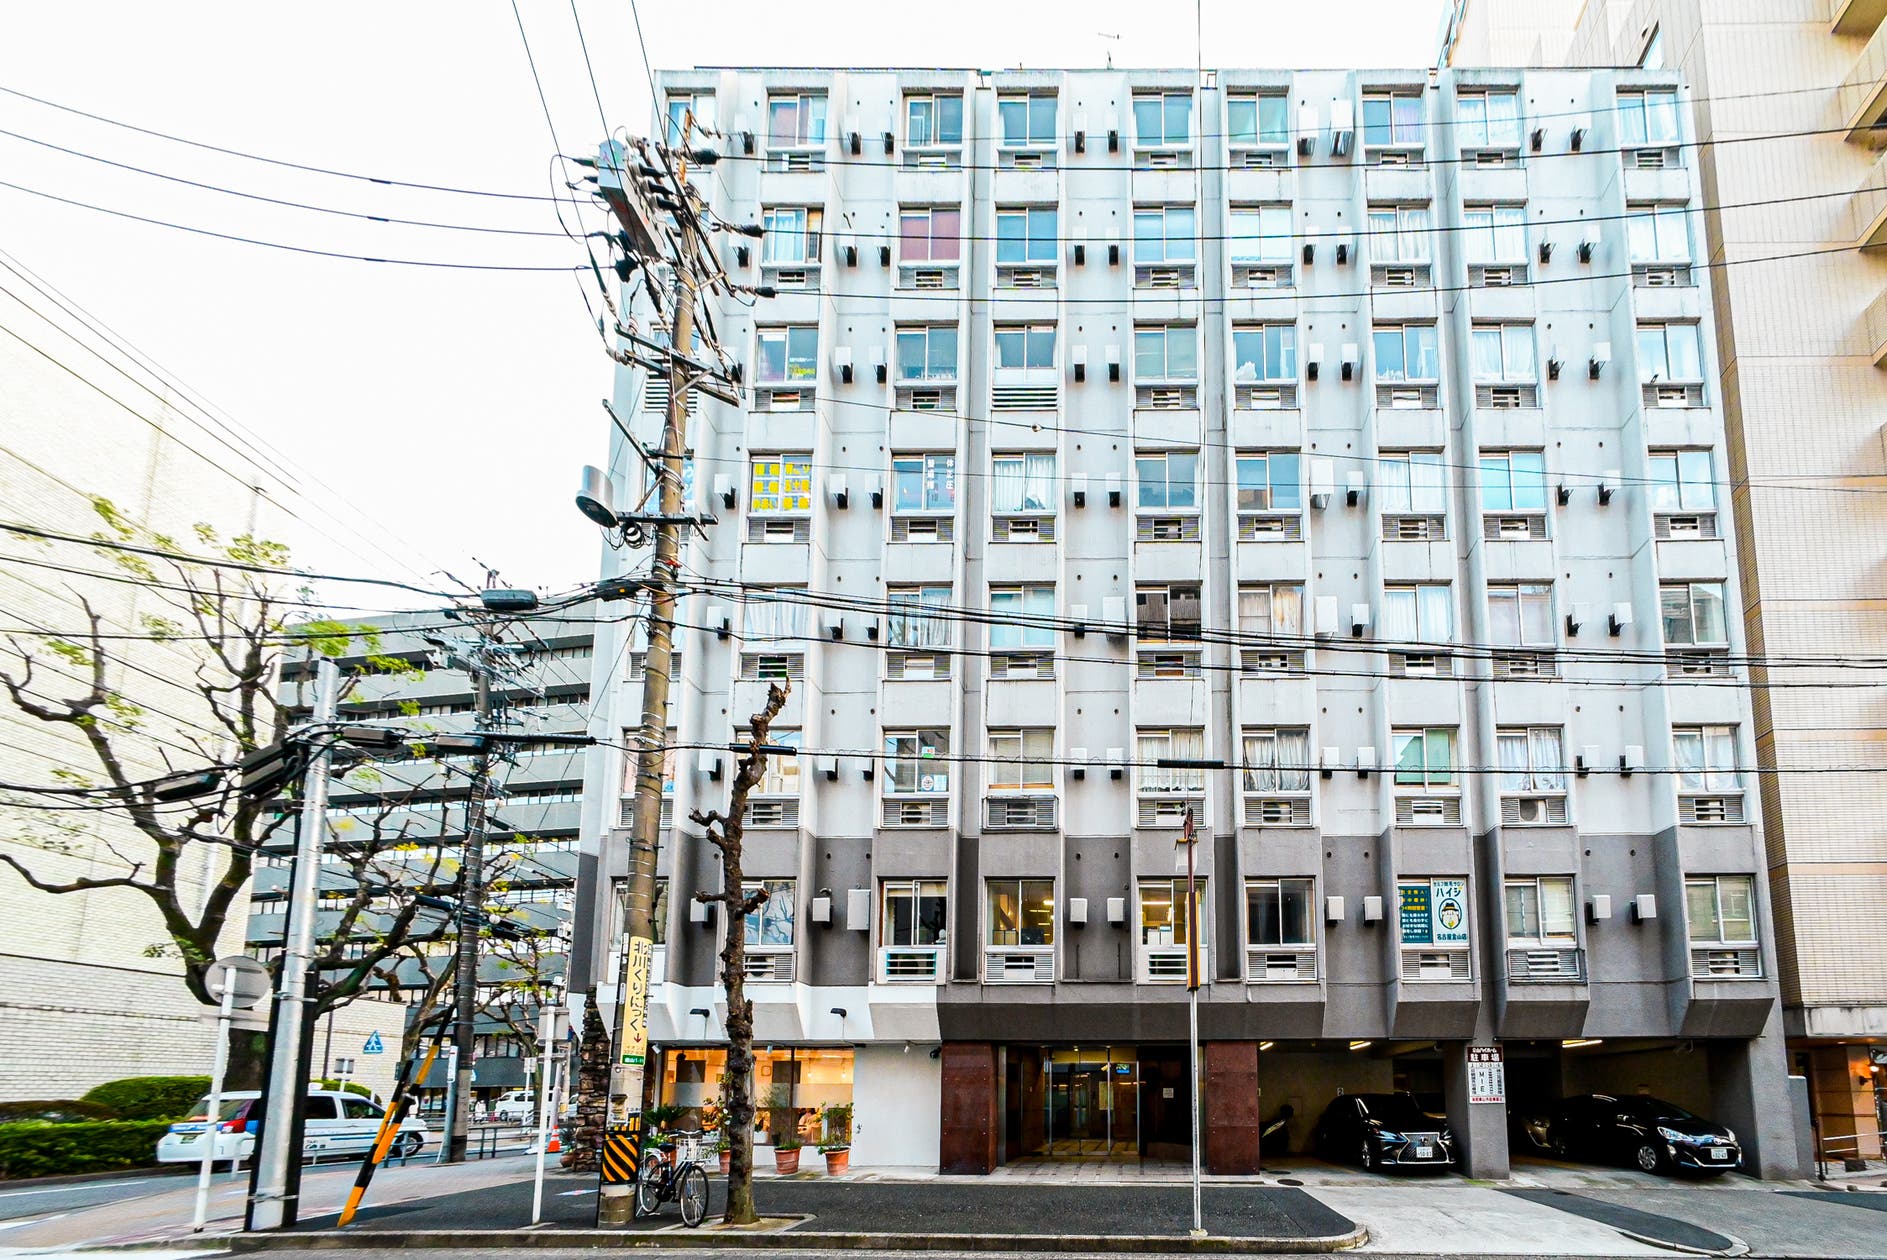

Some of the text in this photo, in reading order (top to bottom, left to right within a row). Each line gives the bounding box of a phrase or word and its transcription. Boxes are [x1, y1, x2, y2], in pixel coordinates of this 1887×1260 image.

[1437, 933, 1467, 941] 名古屋金山店
[630, 941, 648, 1032] 北川くりにっく
[1470, 1053, 1500, 1062] 駐車場
